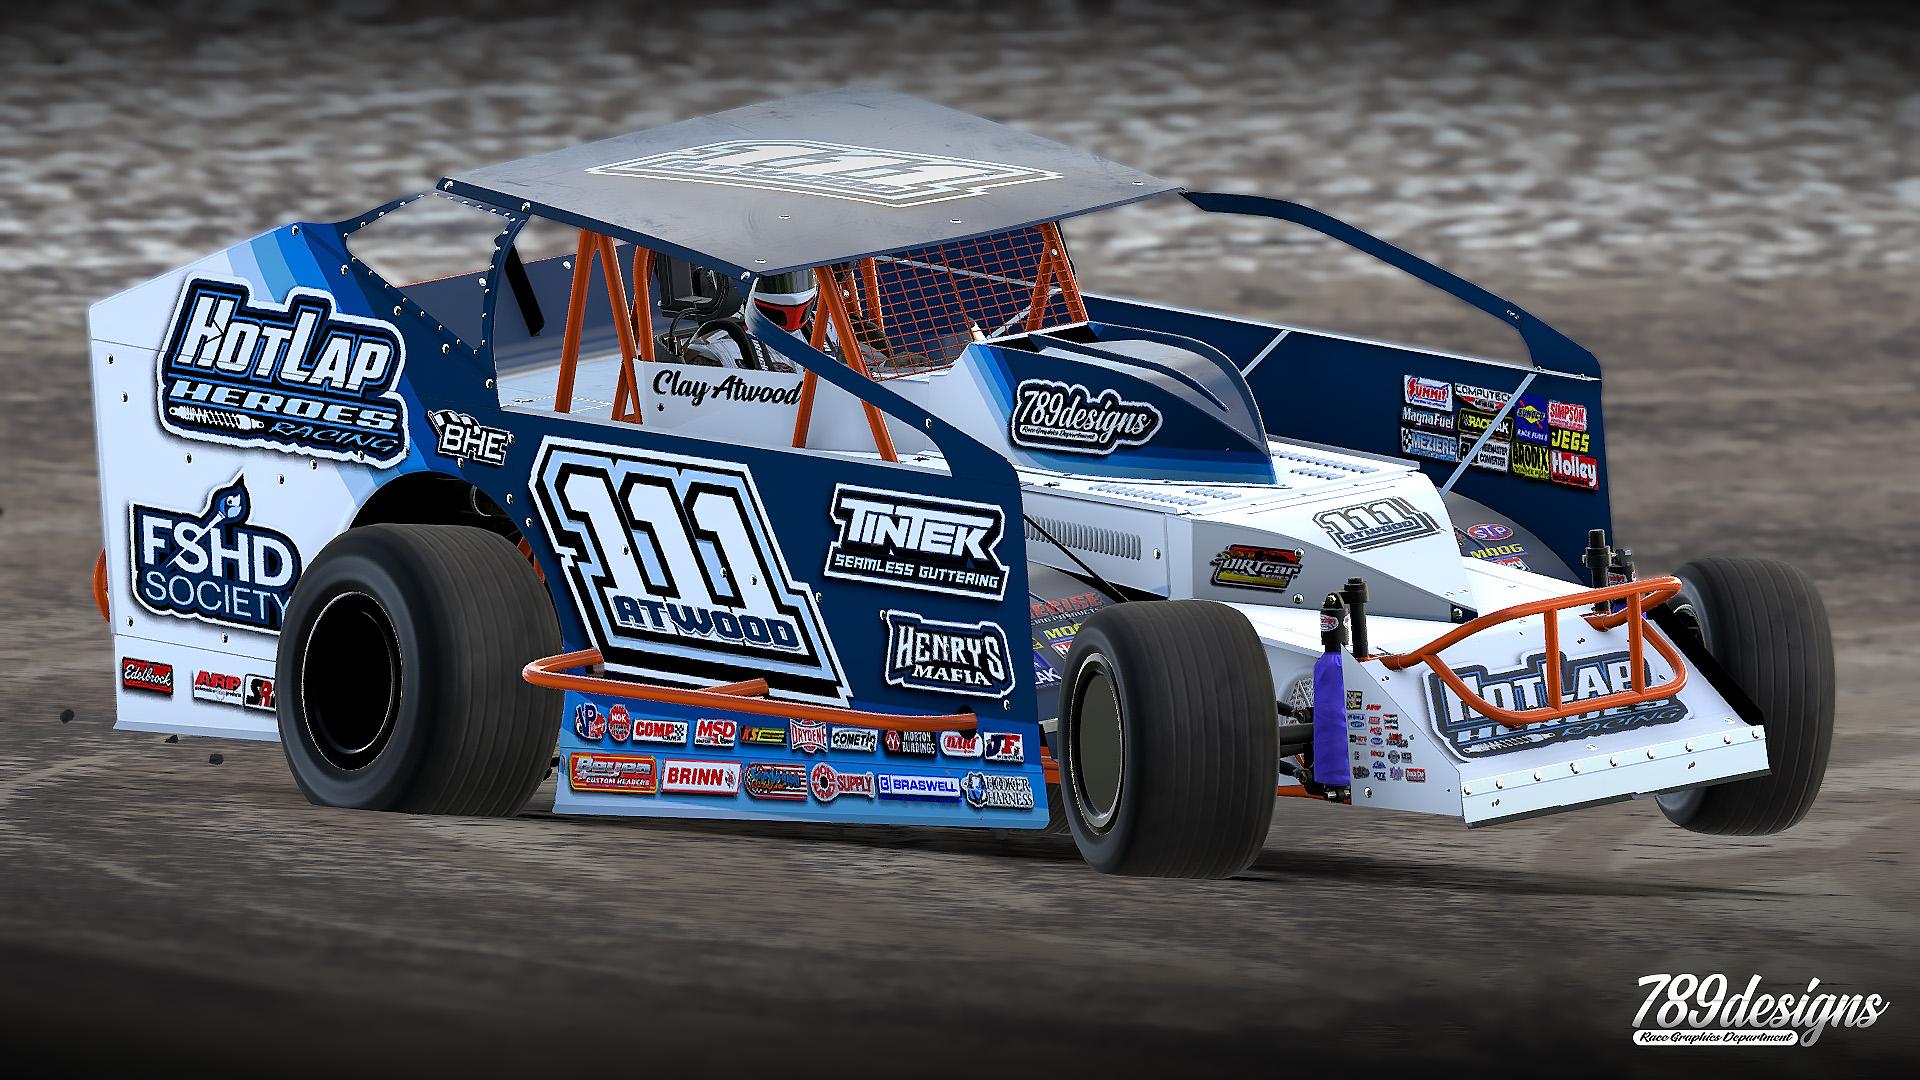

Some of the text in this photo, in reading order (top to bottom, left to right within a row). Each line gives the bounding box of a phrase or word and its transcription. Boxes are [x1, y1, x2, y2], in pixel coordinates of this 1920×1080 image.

[653, 369, 803, 406] Clay Atwood
[171, 380, 397, 430] HEROES
[1550, 404, 1586, 422] SIMPSON
[1020, 391, 1151, 443] 789designs
[1402, 406, 1455, 430] MagnaFuel
[268, 421, 399, 453] RACING
[442, 428, 508, 462] BHE
[1551, 430, 1590, 452] JEGS
[1552, 450, 1597, 487] Holley
[1321, 502, 1408, 537] 111
[1343, 520, 1415, 541] ATWOOD
[1473, 525, 1507, 539] STP
[143, 515, 293, 587] FSHD
[563, 472, 800, 635] 111
[1470, 544, 1525, 558] MOOG
[834, 554, 1000, 589] SEAMLESS GUTTERING
[145, 571, 293, 620] SOCIETY
[613, 595, 802, 651] ATWOOD
[124, 664, 172, 687] Edelbrock
[195, 671, 241, 691] ARP
[912, 664, 993, 686] MAFIA
[635, 721, 676, 737] COMP
[698, 720, 736, 738] MSD
[1562, 708, 1681, 737] RACING
[792, 724, 826, 744] DRYDENE
[904, 731, 931, 742] MORTON
[902, 742, 936, 754] BUILDINGS
[586, 777, 651, 787] CUSTOM HEADERS
[667, 767, 724, 787] BRINN
[837, 775, 873, 793] SUPPLY
[893, 781, 958, 793] BRASWELL
